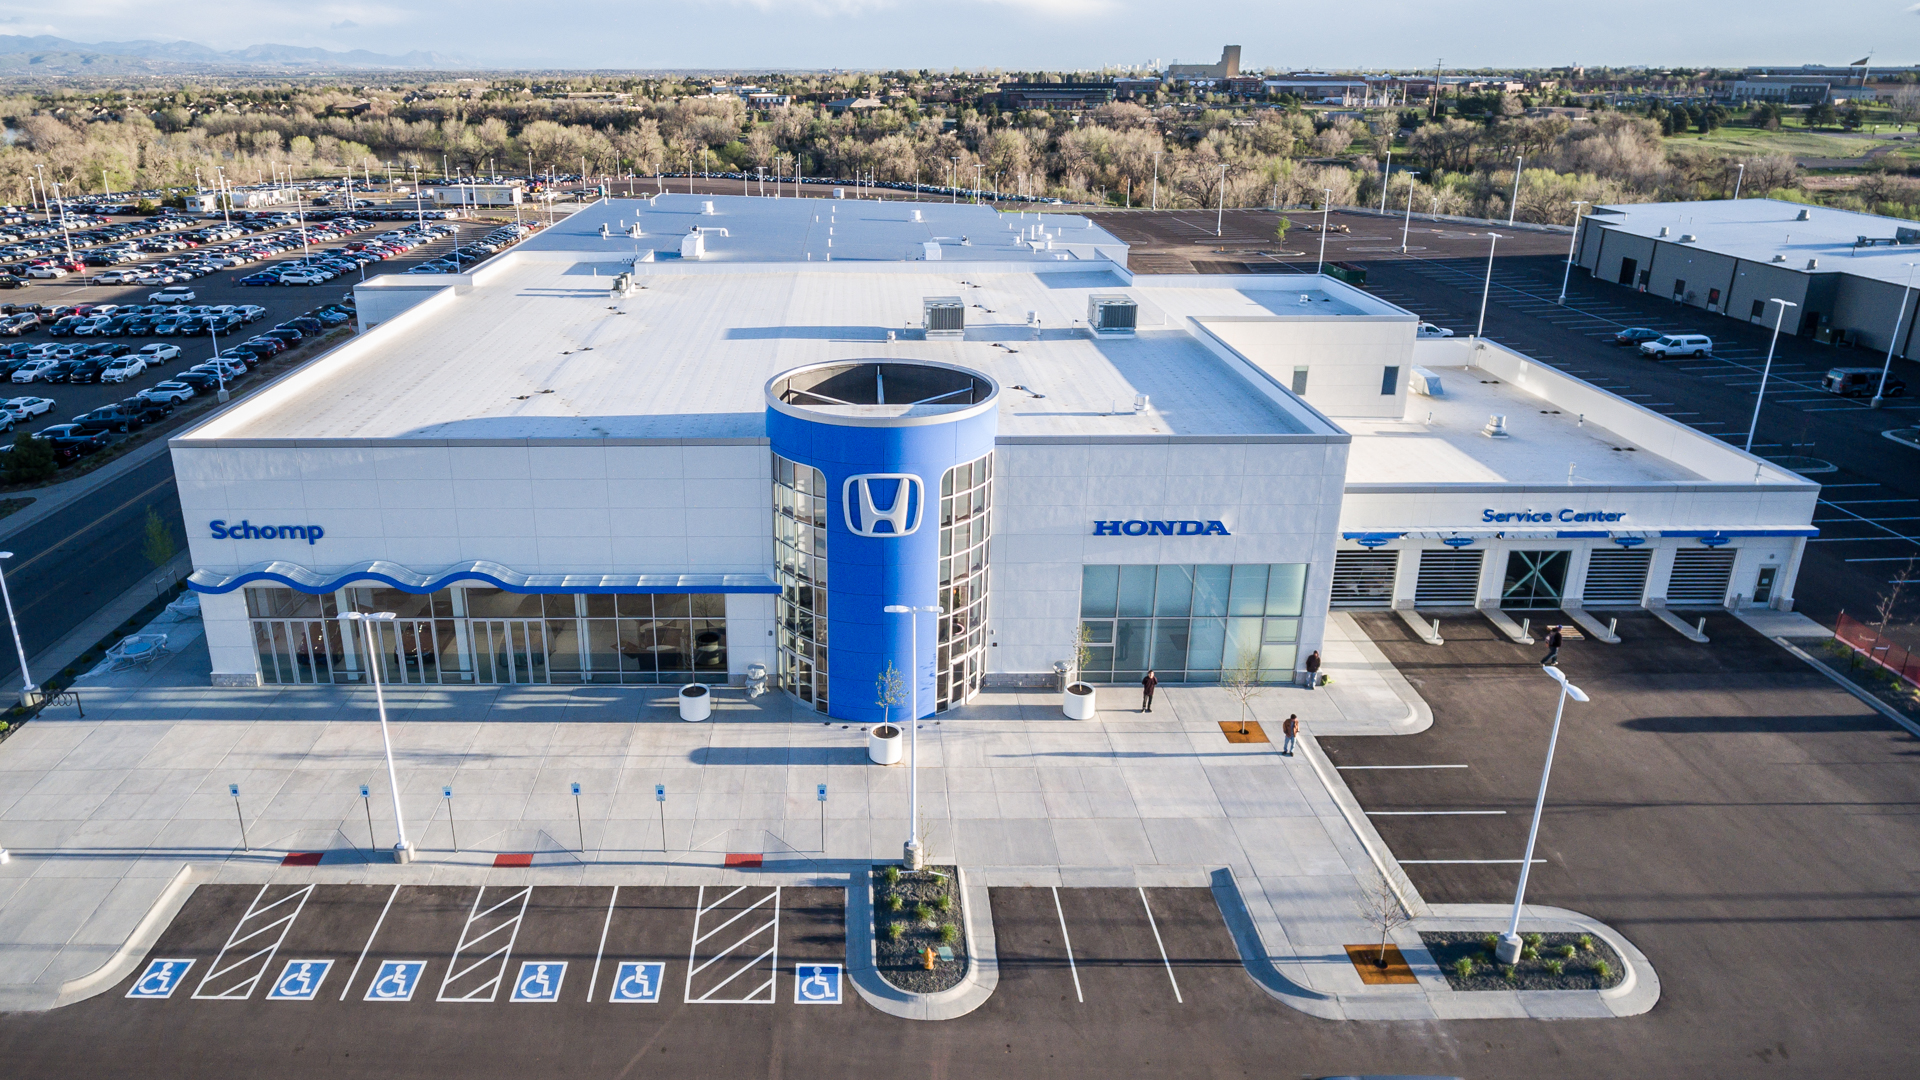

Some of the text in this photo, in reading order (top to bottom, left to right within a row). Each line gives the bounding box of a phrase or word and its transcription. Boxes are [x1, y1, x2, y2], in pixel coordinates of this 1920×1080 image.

[1482, 508, 1626, 522] Service Center
[209, 519, 325, 545] Schomp
[1093, 520, 1231, 536] HONDA
